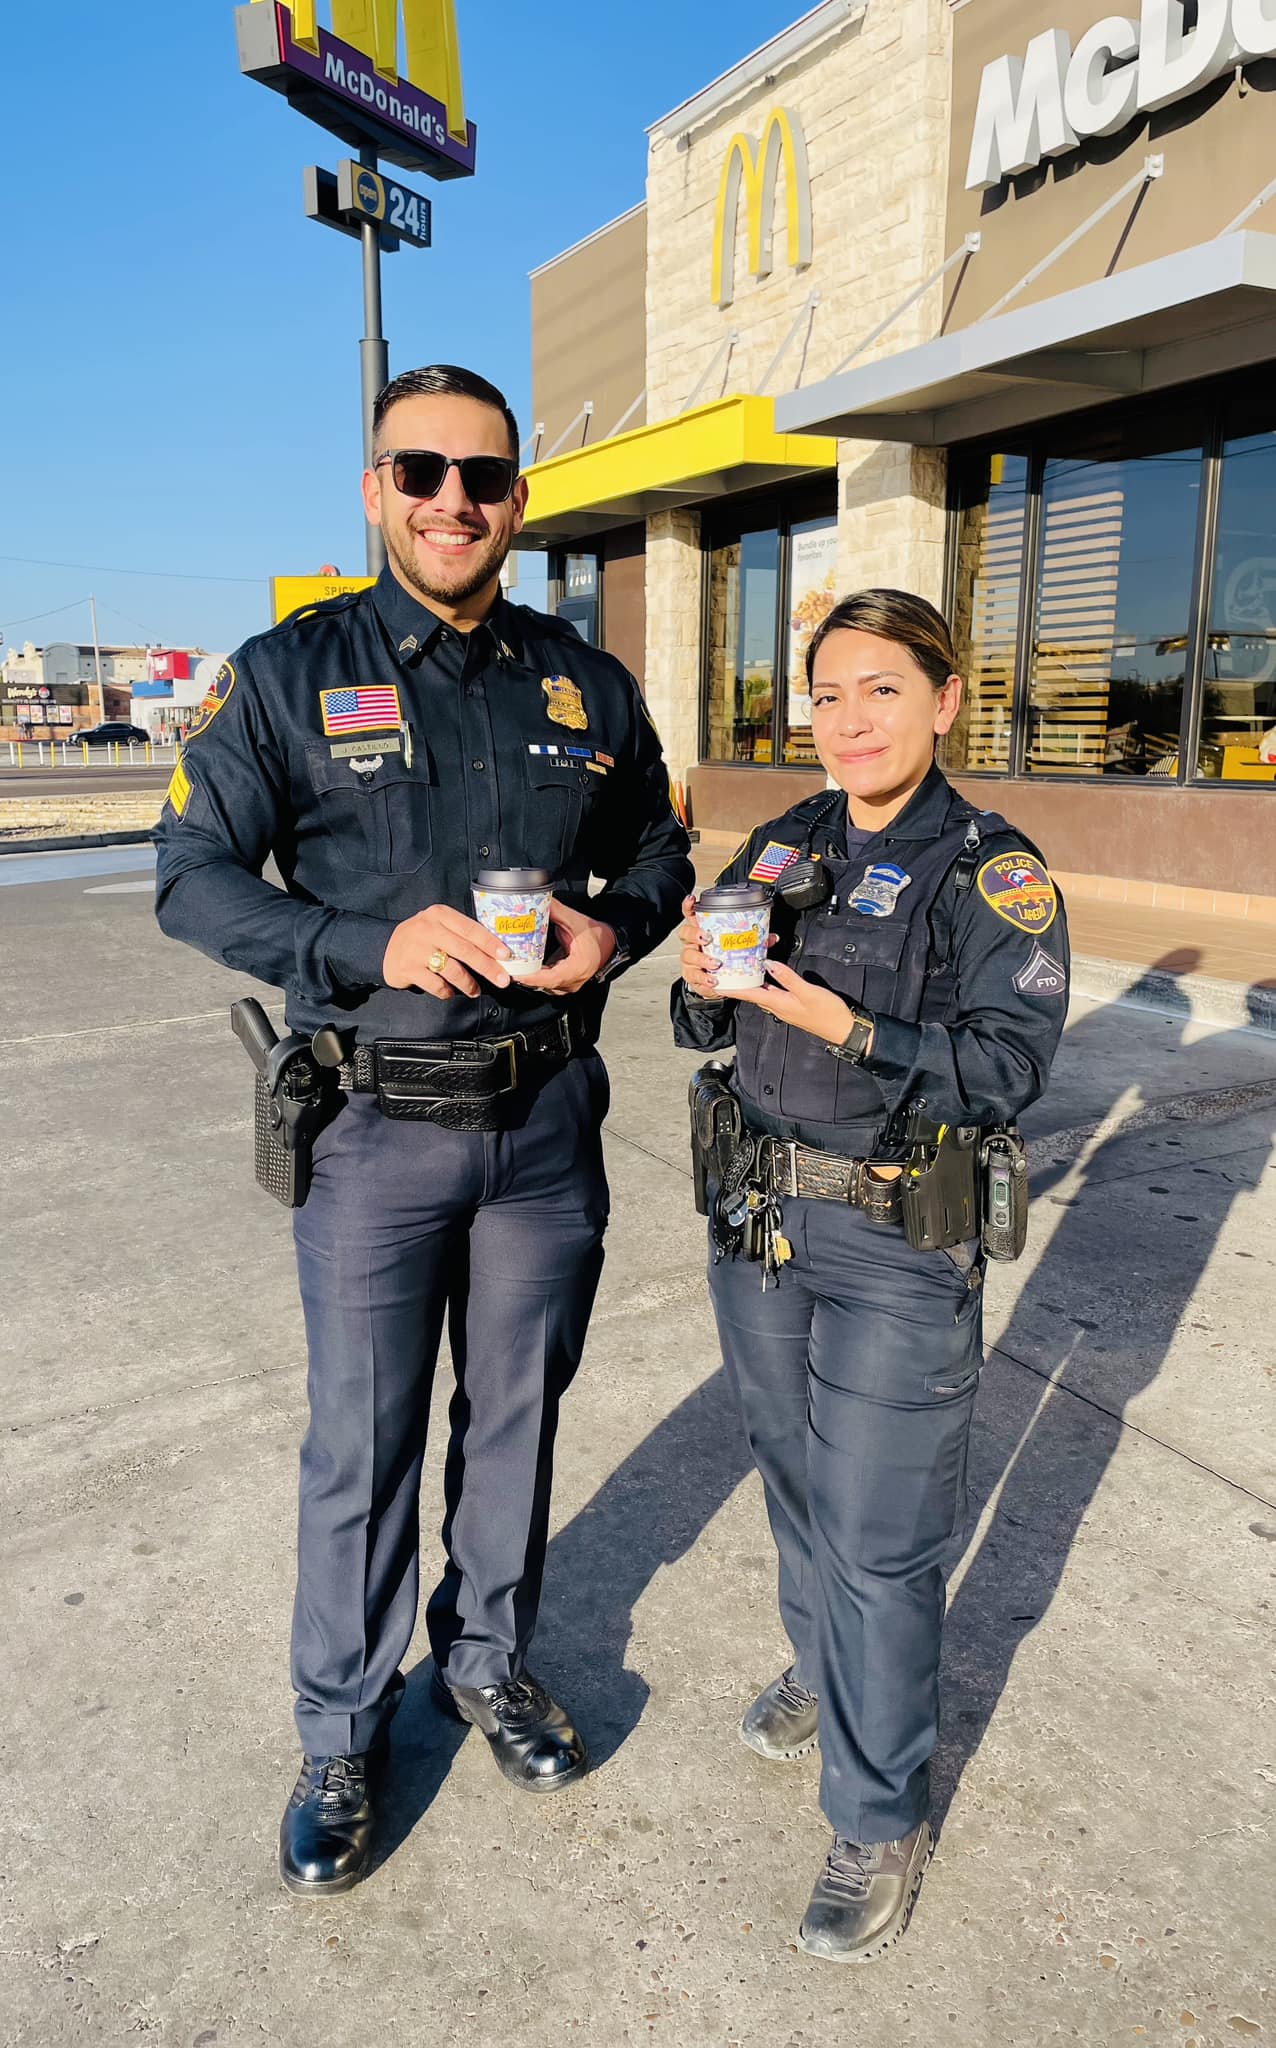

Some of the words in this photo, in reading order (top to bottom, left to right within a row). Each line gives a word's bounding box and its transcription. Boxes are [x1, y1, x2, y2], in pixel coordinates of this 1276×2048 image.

[325, 51, 445, 146] McDonald's
[390, 187, 420, 236] 24
[325, 586, 355, 596] SPICY
[994, 858, 1034, 875] POLICE
[1036, 976, 1058, 989] FTO
